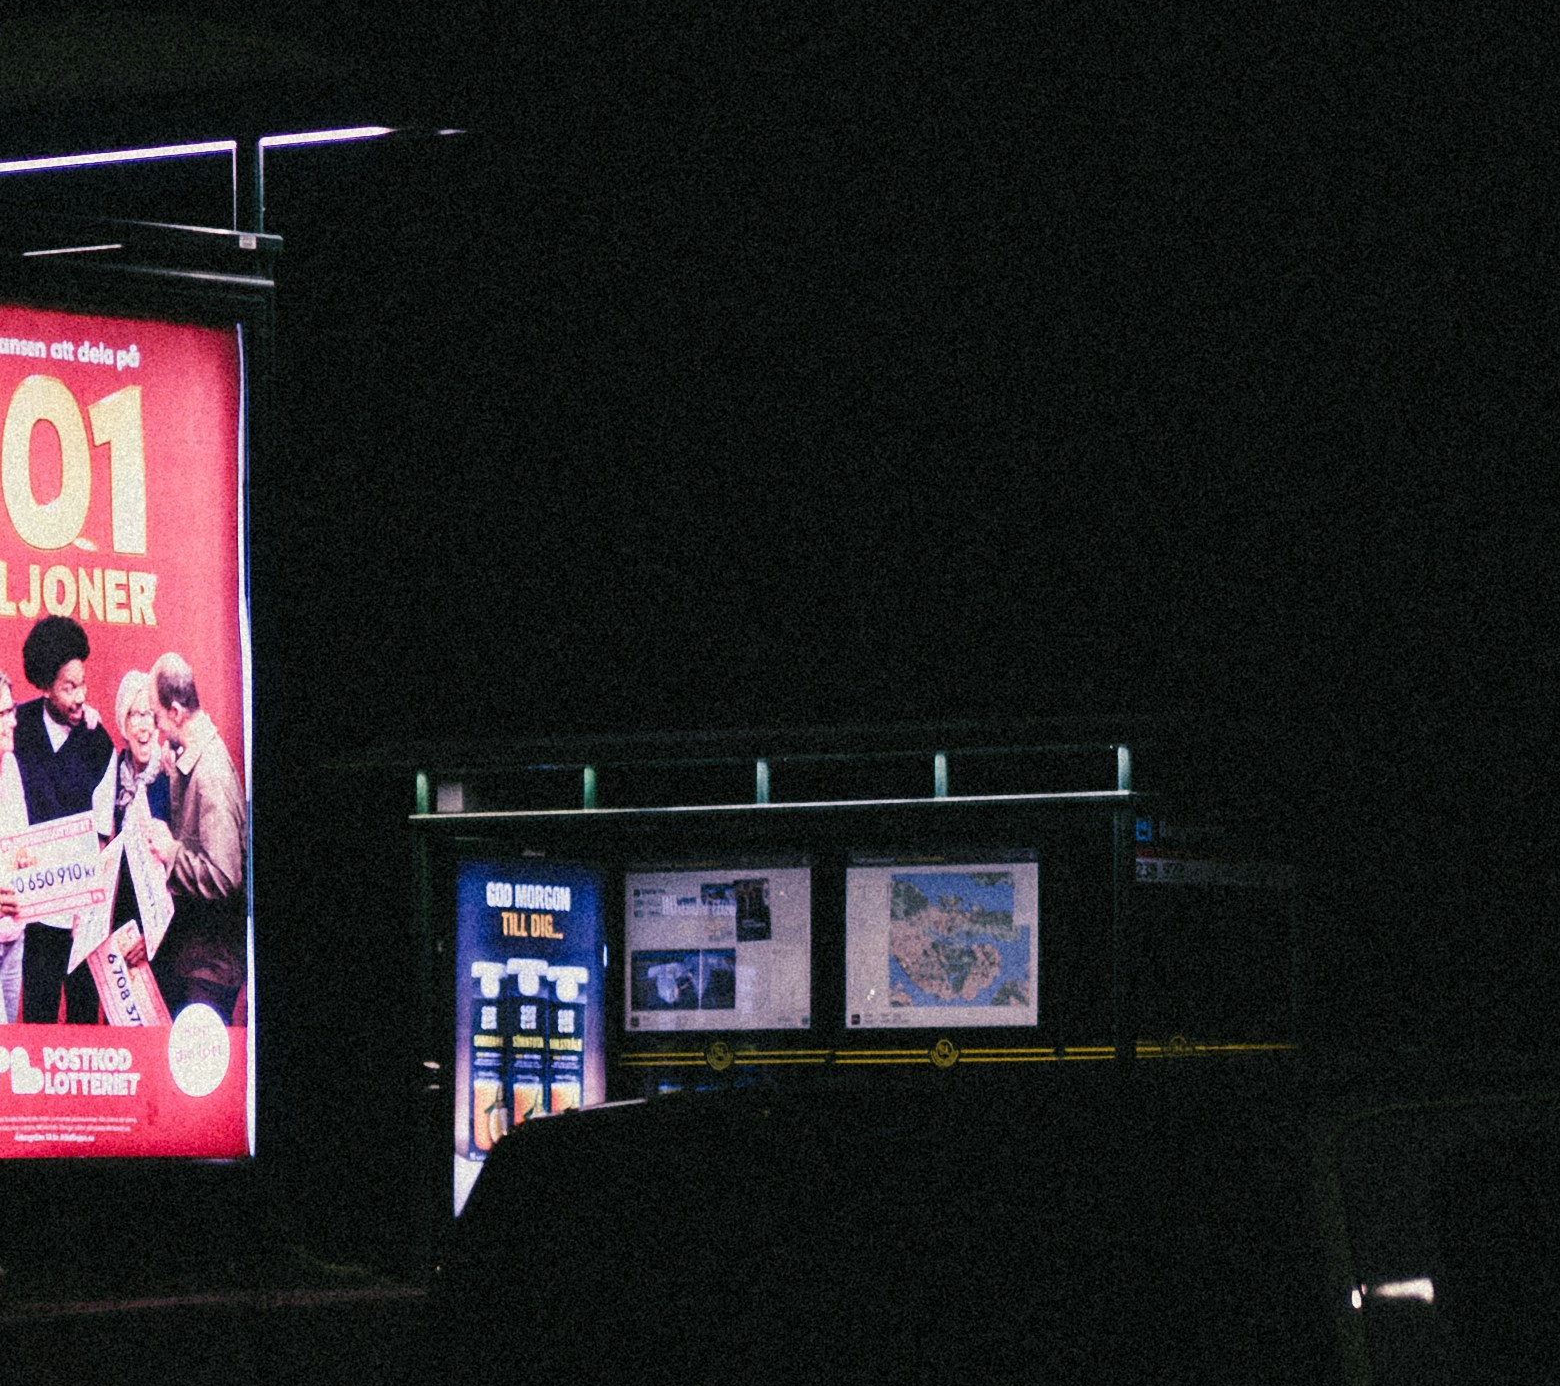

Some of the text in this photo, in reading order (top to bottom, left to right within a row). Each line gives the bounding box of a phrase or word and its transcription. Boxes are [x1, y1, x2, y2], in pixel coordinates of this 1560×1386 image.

[50, 340, 75, 362] att
[77, 340, 115, 366] dela
[116, 343, 141, 371] på
[28, 869, 54, 891] 650
[57, 863, 82, 884] 910
[486, 881, 571, 912] GOD MORGON
[501, 911, 528, 937] TILL
[42, 1046, 132, 1071] POSTKOD
[44, 1071, 141, 1096] LOTTERIET
